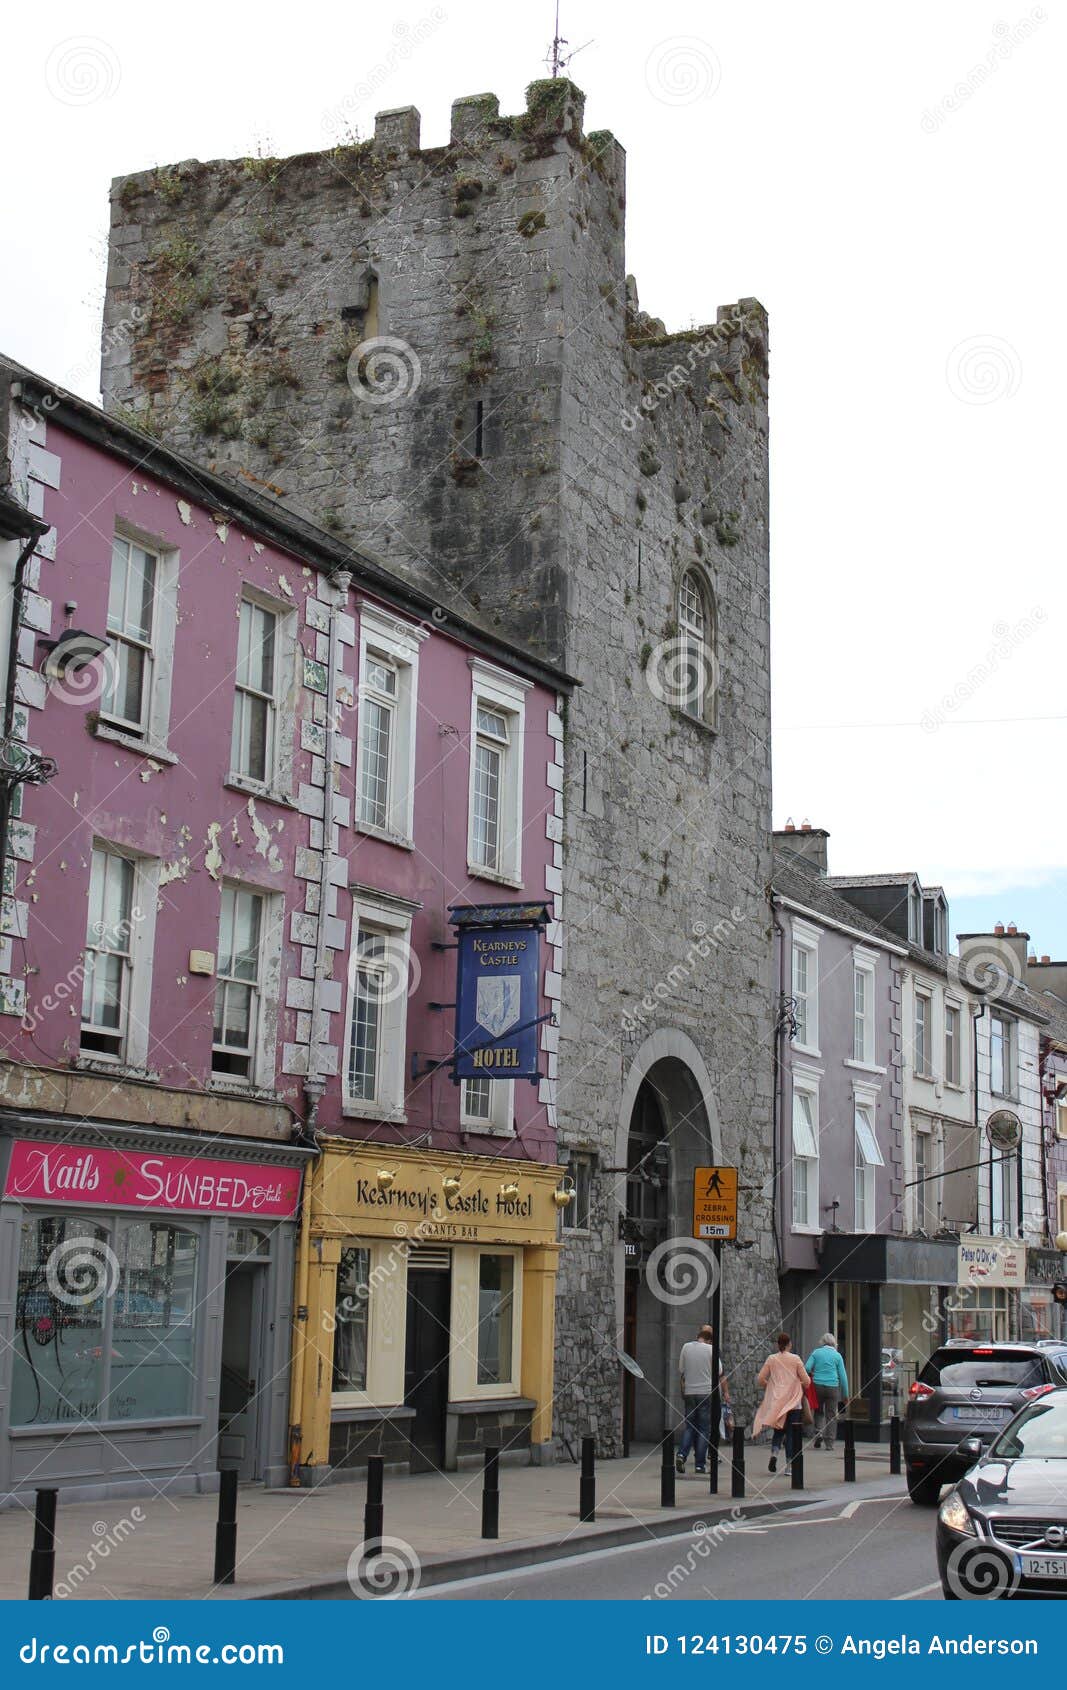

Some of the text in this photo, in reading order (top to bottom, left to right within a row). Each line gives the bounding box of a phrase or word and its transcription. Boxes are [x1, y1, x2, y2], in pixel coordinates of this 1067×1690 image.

[473, 939, 526, 952] KEARNEYS
[480, 953, 518, 966] CASTLE
[473, 1048, 520, 1068] HOTEL
[14, 1150, 99, 1194] Nails
[136, 1160, 248, 1208] SUNBED
[357, 1179, 437, 1214] Kearney's
[496, 1193, 532, 1217] Hotel
[703, 1204, 727, 1212] ZEBRA
[695, 1214, 734, 1222] CROSSING
[461, 1226, 478, 1237] BAR
[704, 1226, 725, 1235] 15m
[624, 1244, 636, 1255] TEL
